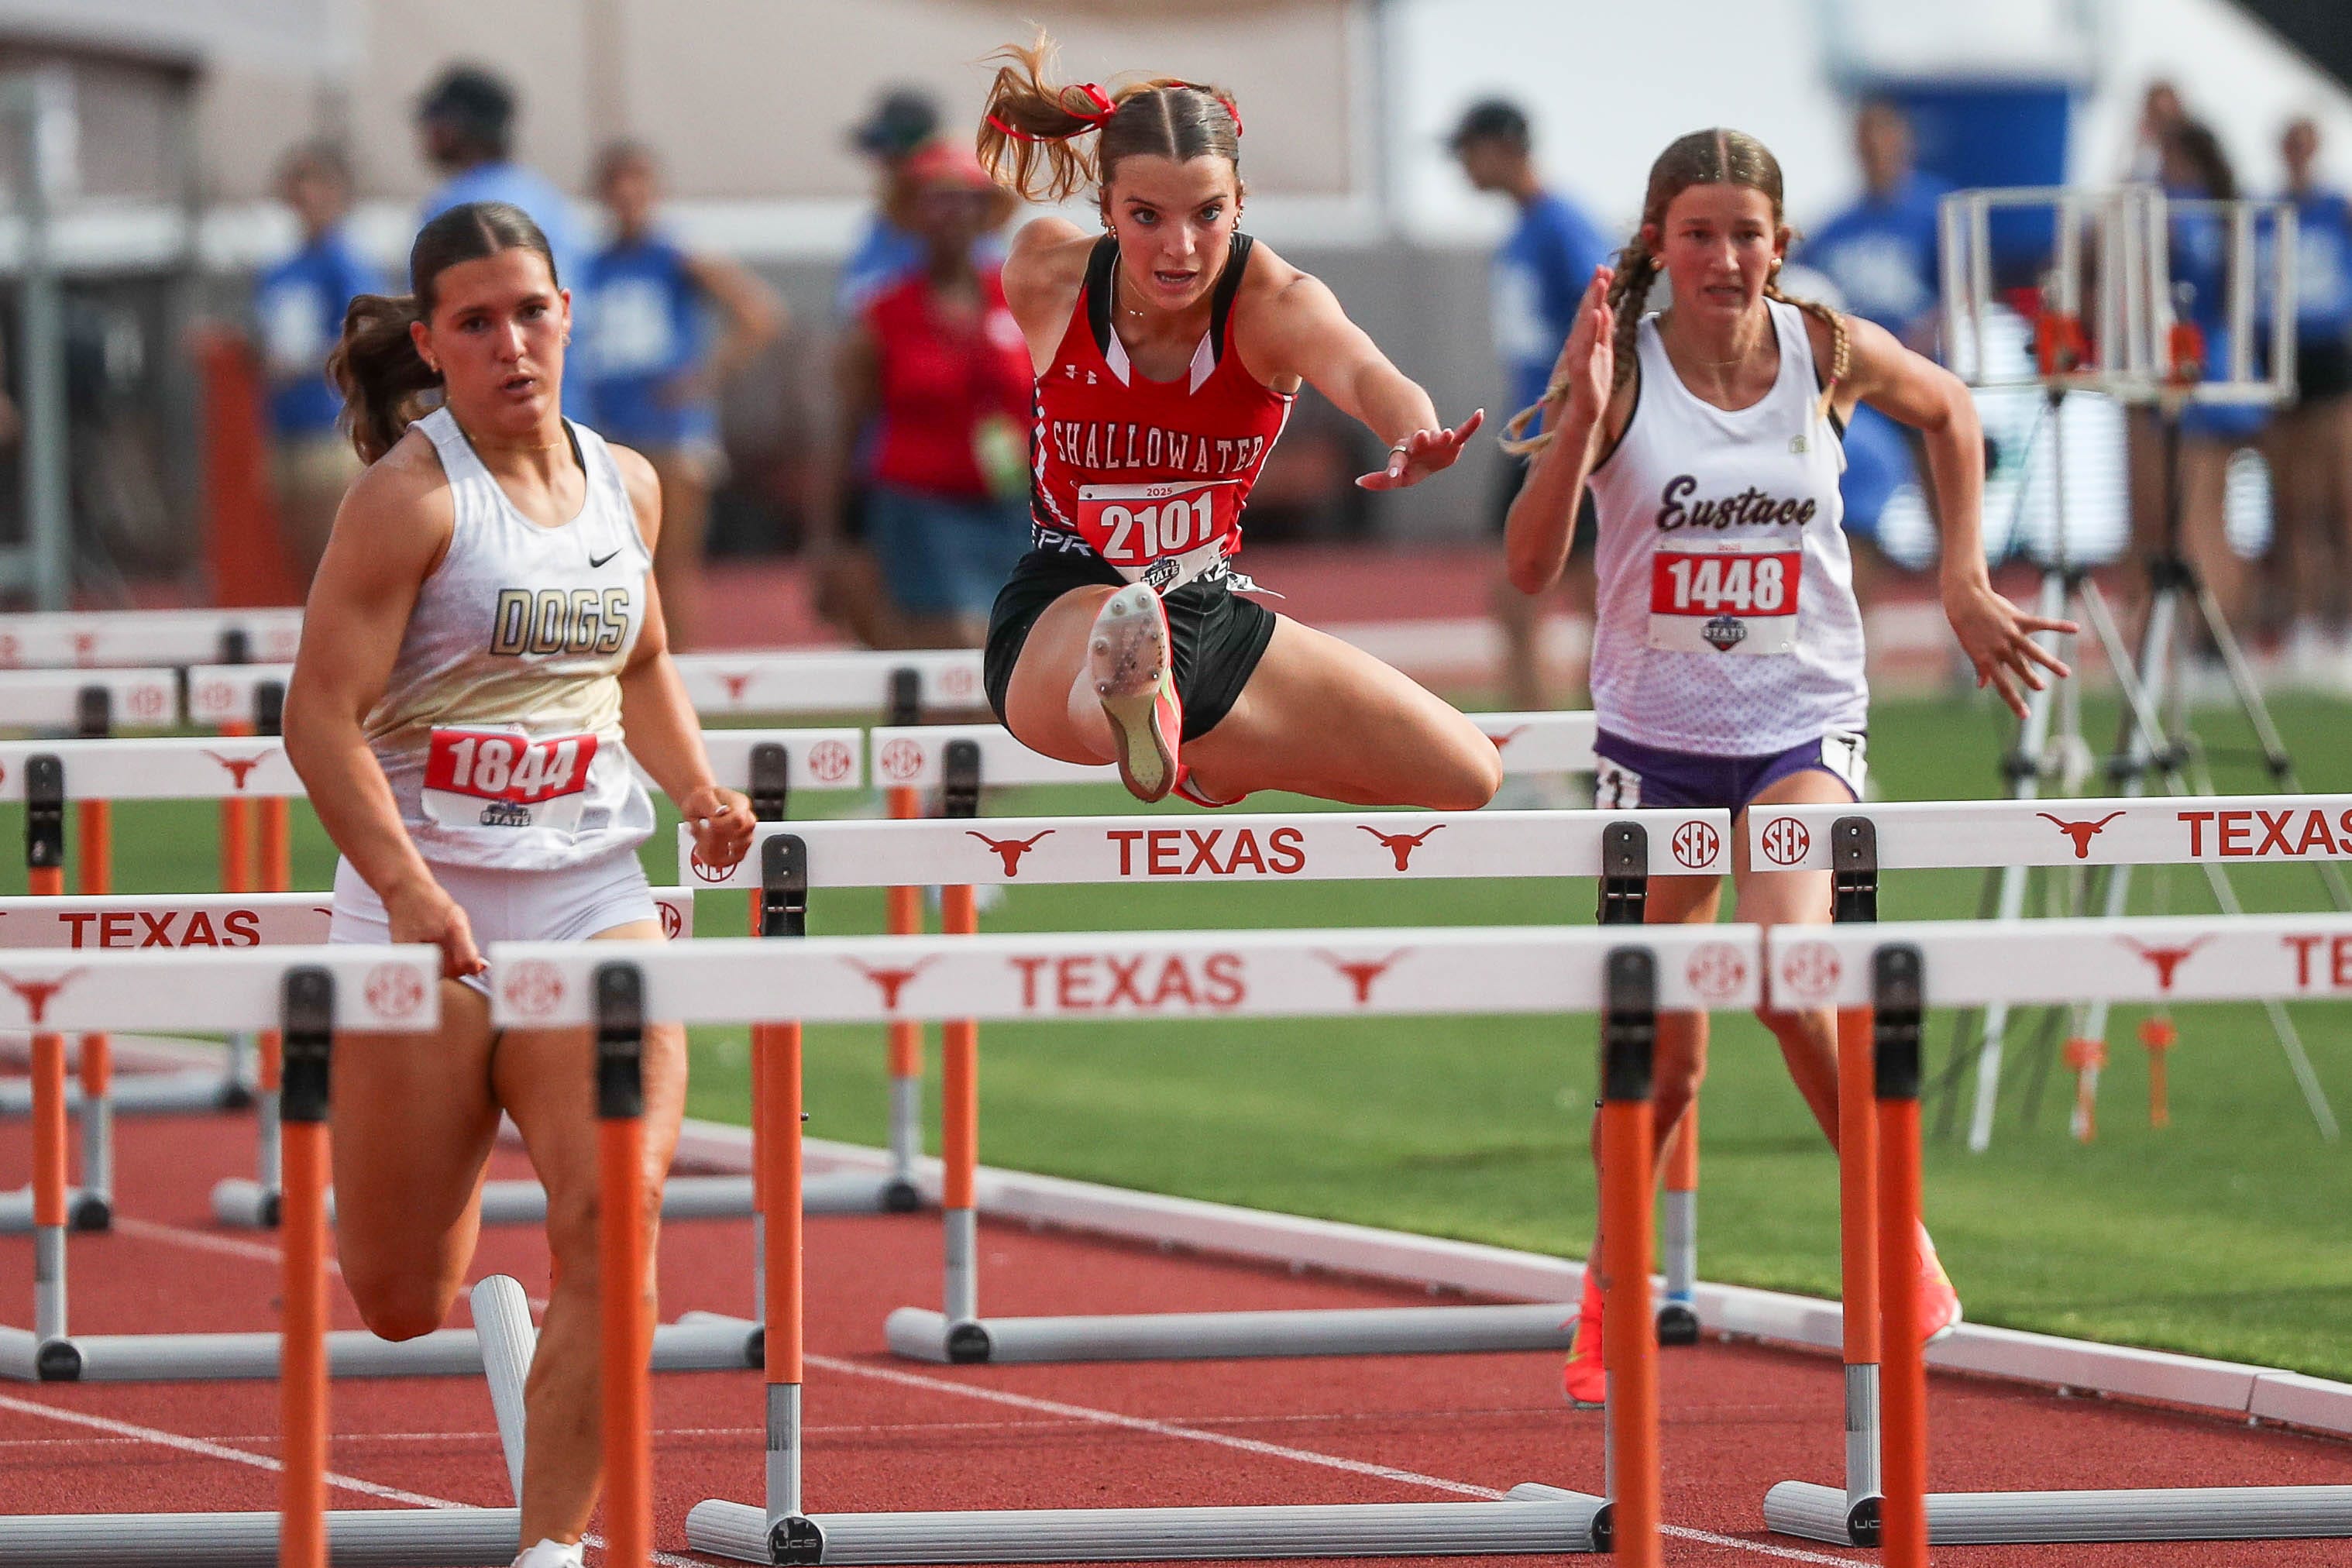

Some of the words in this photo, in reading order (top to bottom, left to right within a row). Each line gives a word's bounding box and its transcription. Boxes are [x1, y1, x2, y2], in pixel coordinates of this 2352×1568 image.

[1053, 419, 1265, 475] SHALLOWATER
[1147, 487, 1173, 497] 2025
[1656, 474, 1817, 533] Eustace
[1100, 491, 1212, 559] 2101
[1668, 557, 1785, 610] 1448
[490, 588, 629, 655] DOGS
[449, 737, 579, 798] 1844
[481, 811, 531, 826] STATE
[1762, 817, 1810, 865] SEC
[1107, 827, 1305, 876] TEXAS
[1673, 820, 1720, 868] SEC
[59, 910, 261, 950] TEXAS
[1010, 953, 1246, 1009] TEXAS
[775, 1538, 817, 1549] UCS
[1855, 1519, 1881, 1529] UC
